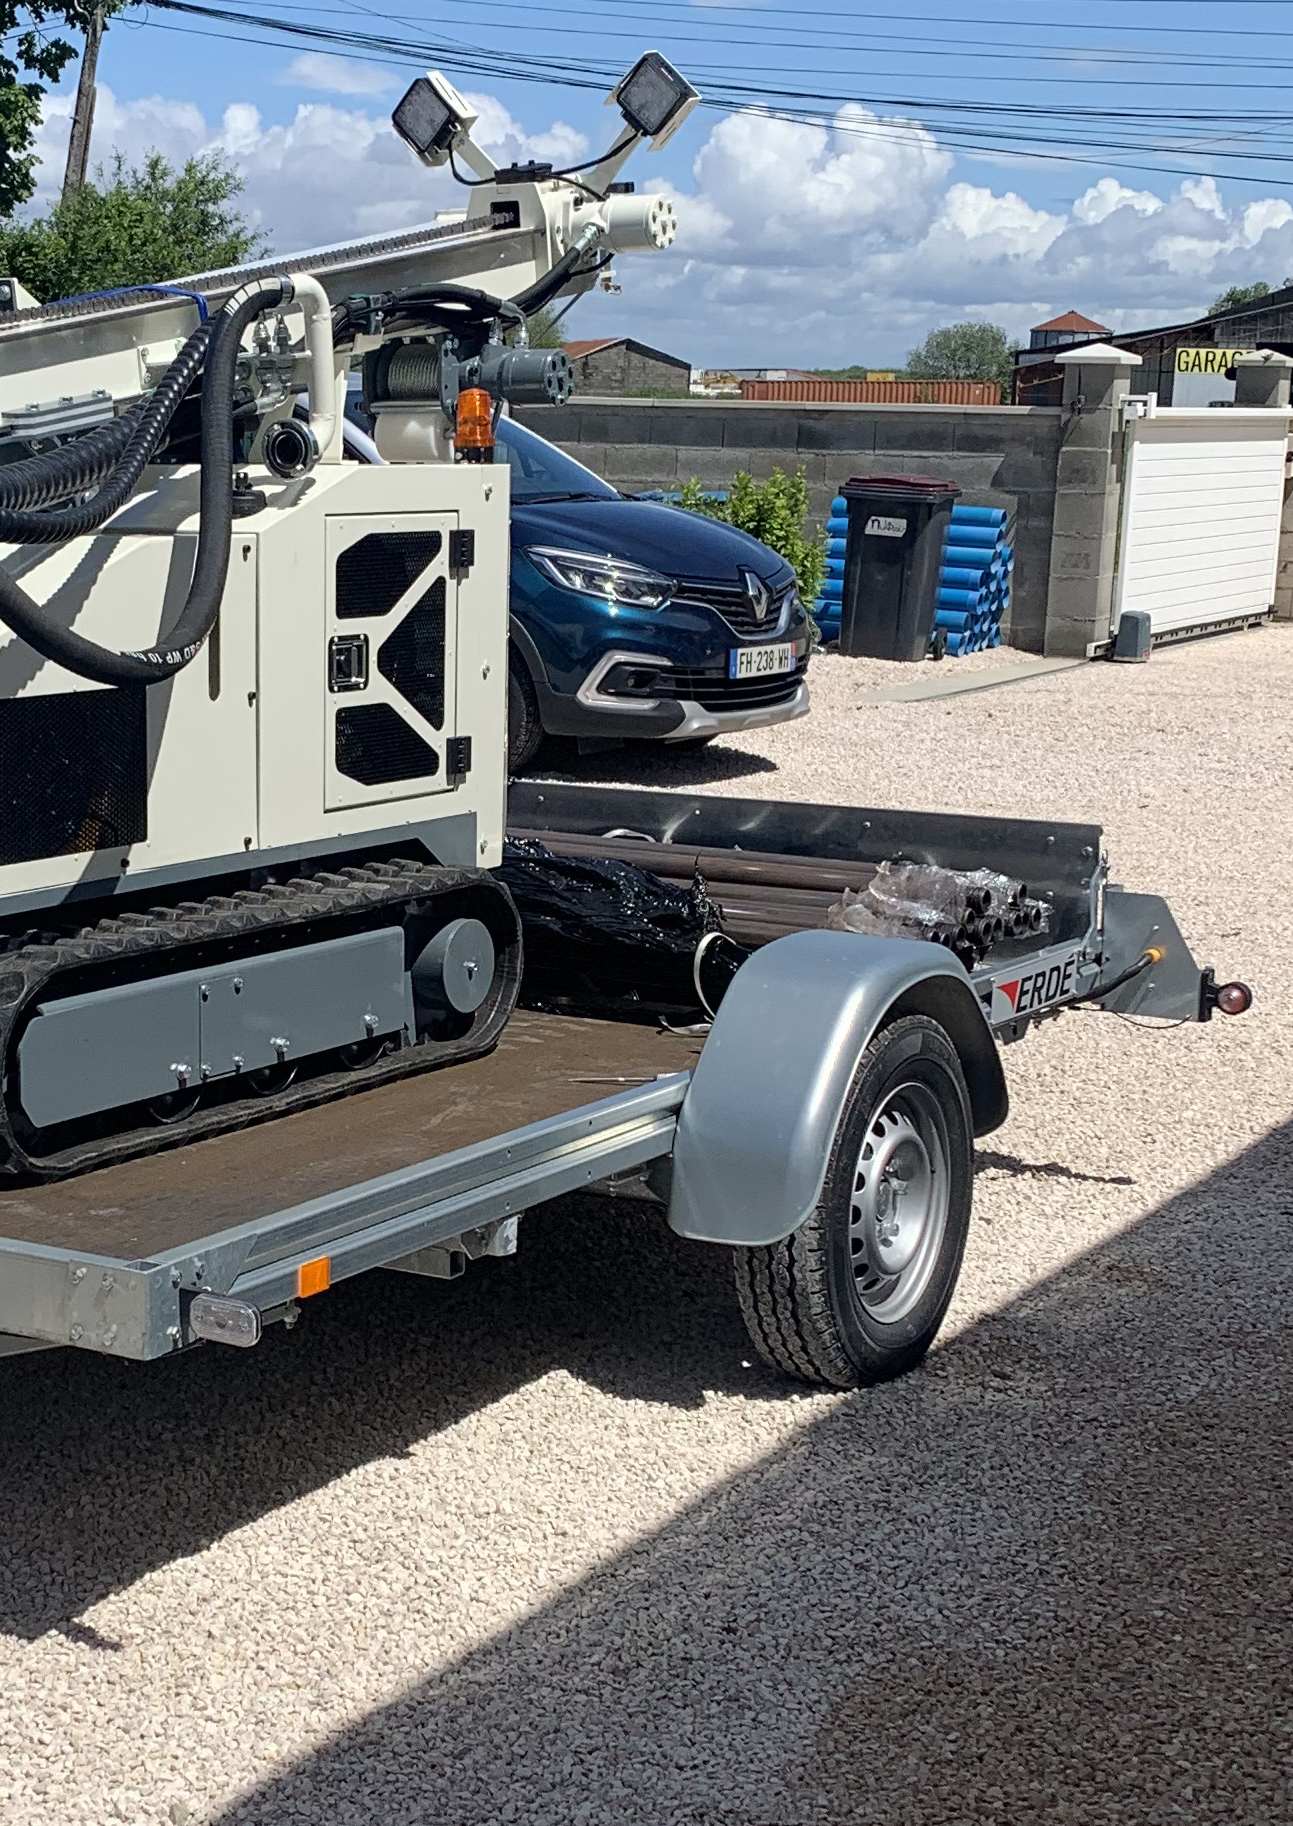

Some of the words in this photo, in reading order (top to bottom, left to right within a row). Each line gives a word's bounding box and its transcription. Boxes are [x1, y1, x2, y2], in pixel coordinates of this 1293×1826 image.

[1177, 349, 1255, 373] GARA
[147, 652, 163, 664] 10
[166, 650, 183, 664] WP
